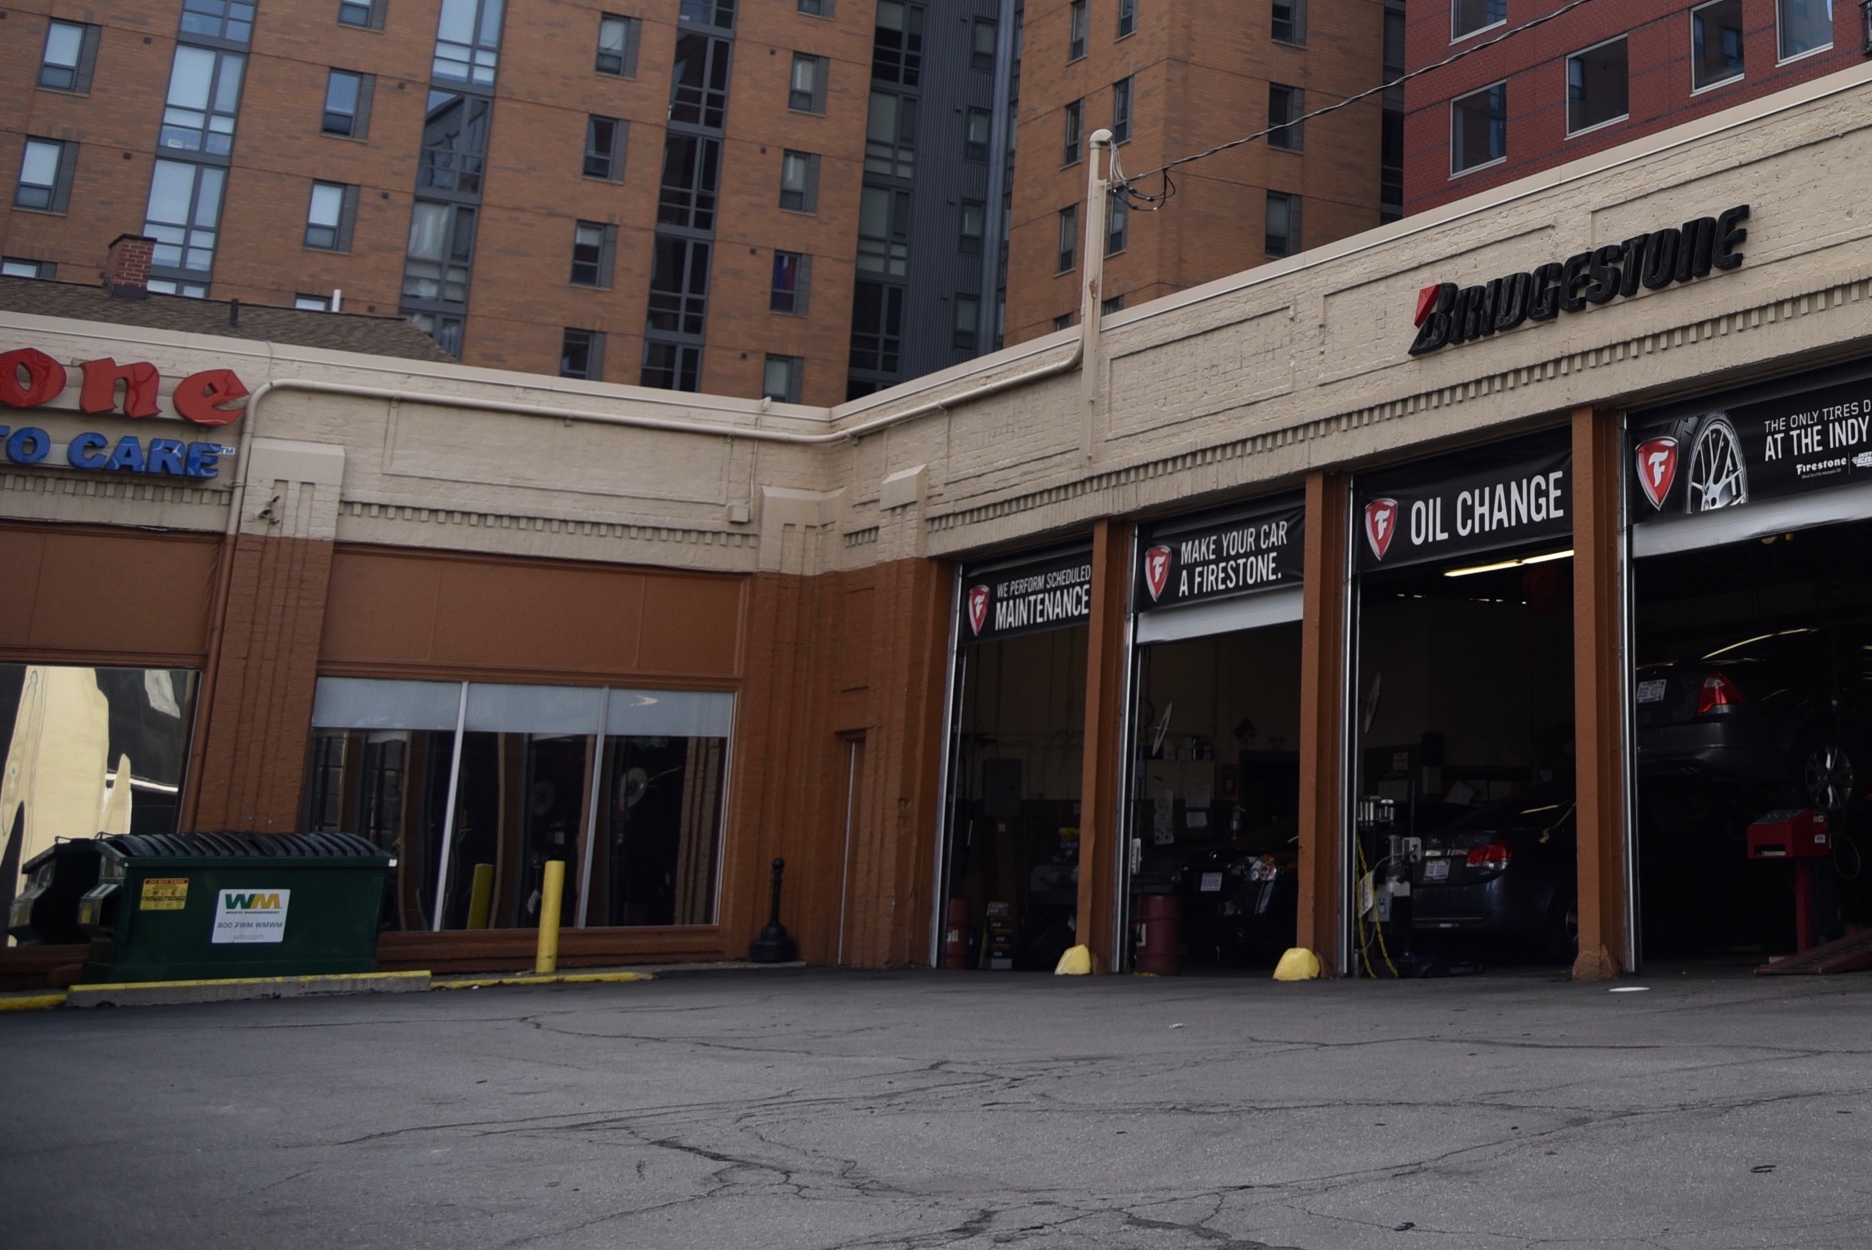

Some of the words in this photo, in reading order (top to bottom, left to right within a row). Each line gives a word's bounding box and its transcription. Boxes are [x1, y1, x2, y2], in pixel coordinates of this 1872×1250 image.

[1407, 204, 1750, 356] BRIDGESTONE
[1764, 417, 1786, 434] THE
[1789, 410, 1819, 430] ONLY
[1822, 402, 1859, 421] TIRES
[1764, 432, 1786, 462] AT
[1792, 425, 1823, 456] THE
[1829, 414, 1870, 449] INDY
[67, 432, 222, 480] CARE
[1796, 457, 1847, 476] Firestone
[1410, 497, 1449, 546] OIL
[1456, 470, 1564, 537] CHANGE
[1180, 535, 1218, 565] MAKE
[1222, 527, 1256, 557] YOUR
[1260, 520, 1288, 550] CAR
[997, 581, 1009, 598] WE
[1010, 574, 1045, 596] PERFORM
[1046, 564, 1092, 589] SCHEDULED
[1178, 569, 1189, 597] A
[1194, 552, 1282, 594] FIRESTONE.
[995, 584, 1090, 631] MAINTENANCE
[225, 893, 281, 909] WM
